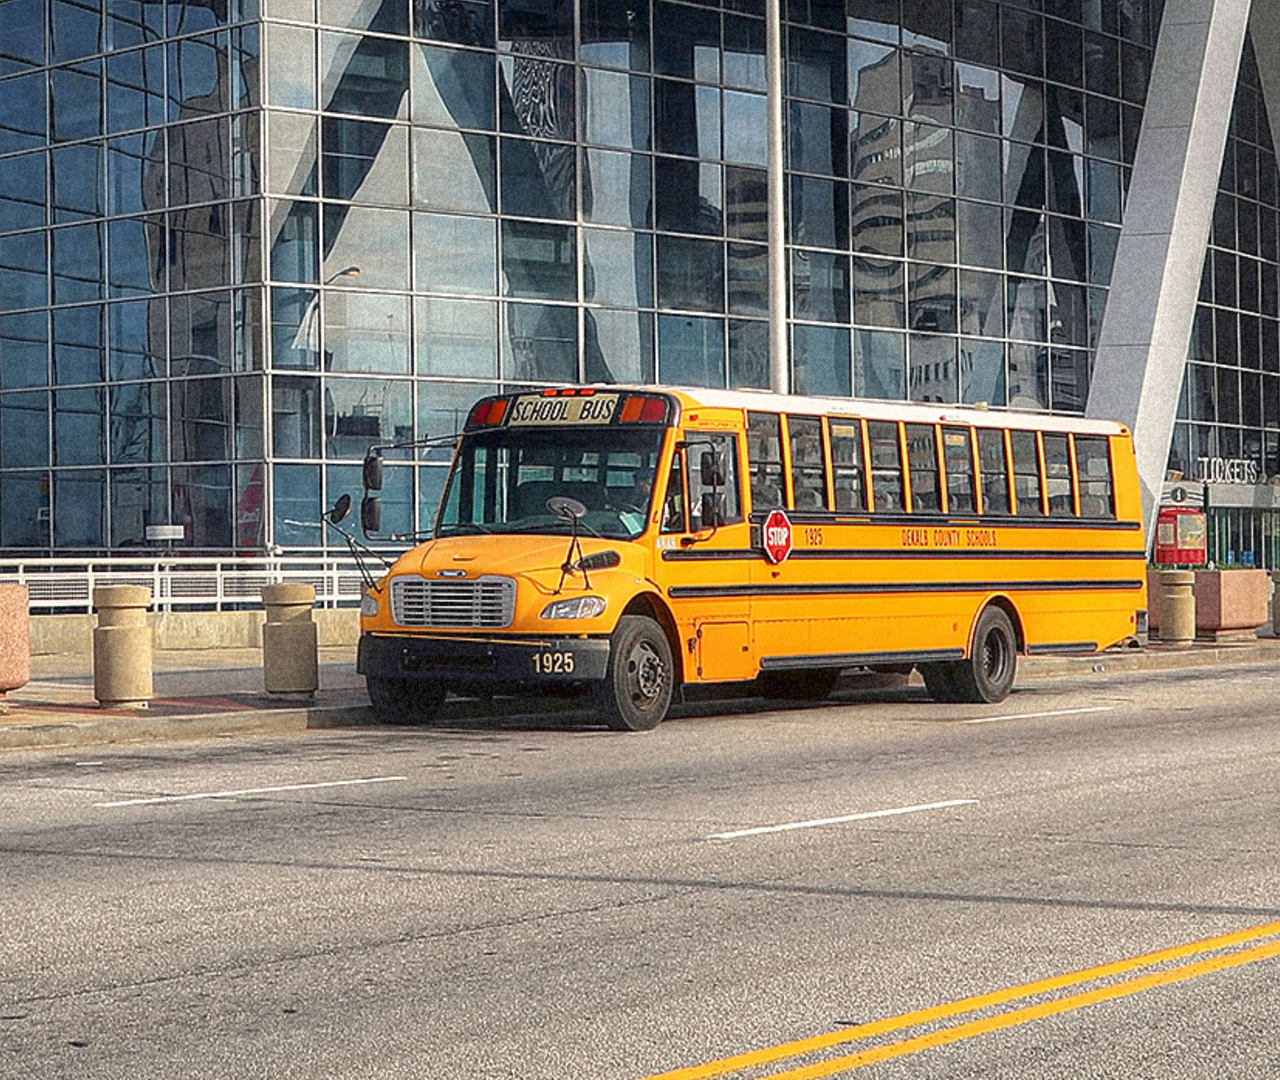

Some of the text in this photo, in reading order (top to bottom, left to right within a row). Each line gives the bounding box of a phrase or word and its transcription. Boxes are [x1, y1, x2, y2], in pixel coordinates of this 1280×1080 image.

[513, 398, 616, 421] SCHOOL BUS
[1197, 457, 1258, 483] TICKETS
[768, 526, 789, 546] STOP
[805, 528, 824, 546] 1925
[902, 529, 997, 546] DEKALB COUNTY SCHOOLS
[532, 652, 574, 673] 1925
